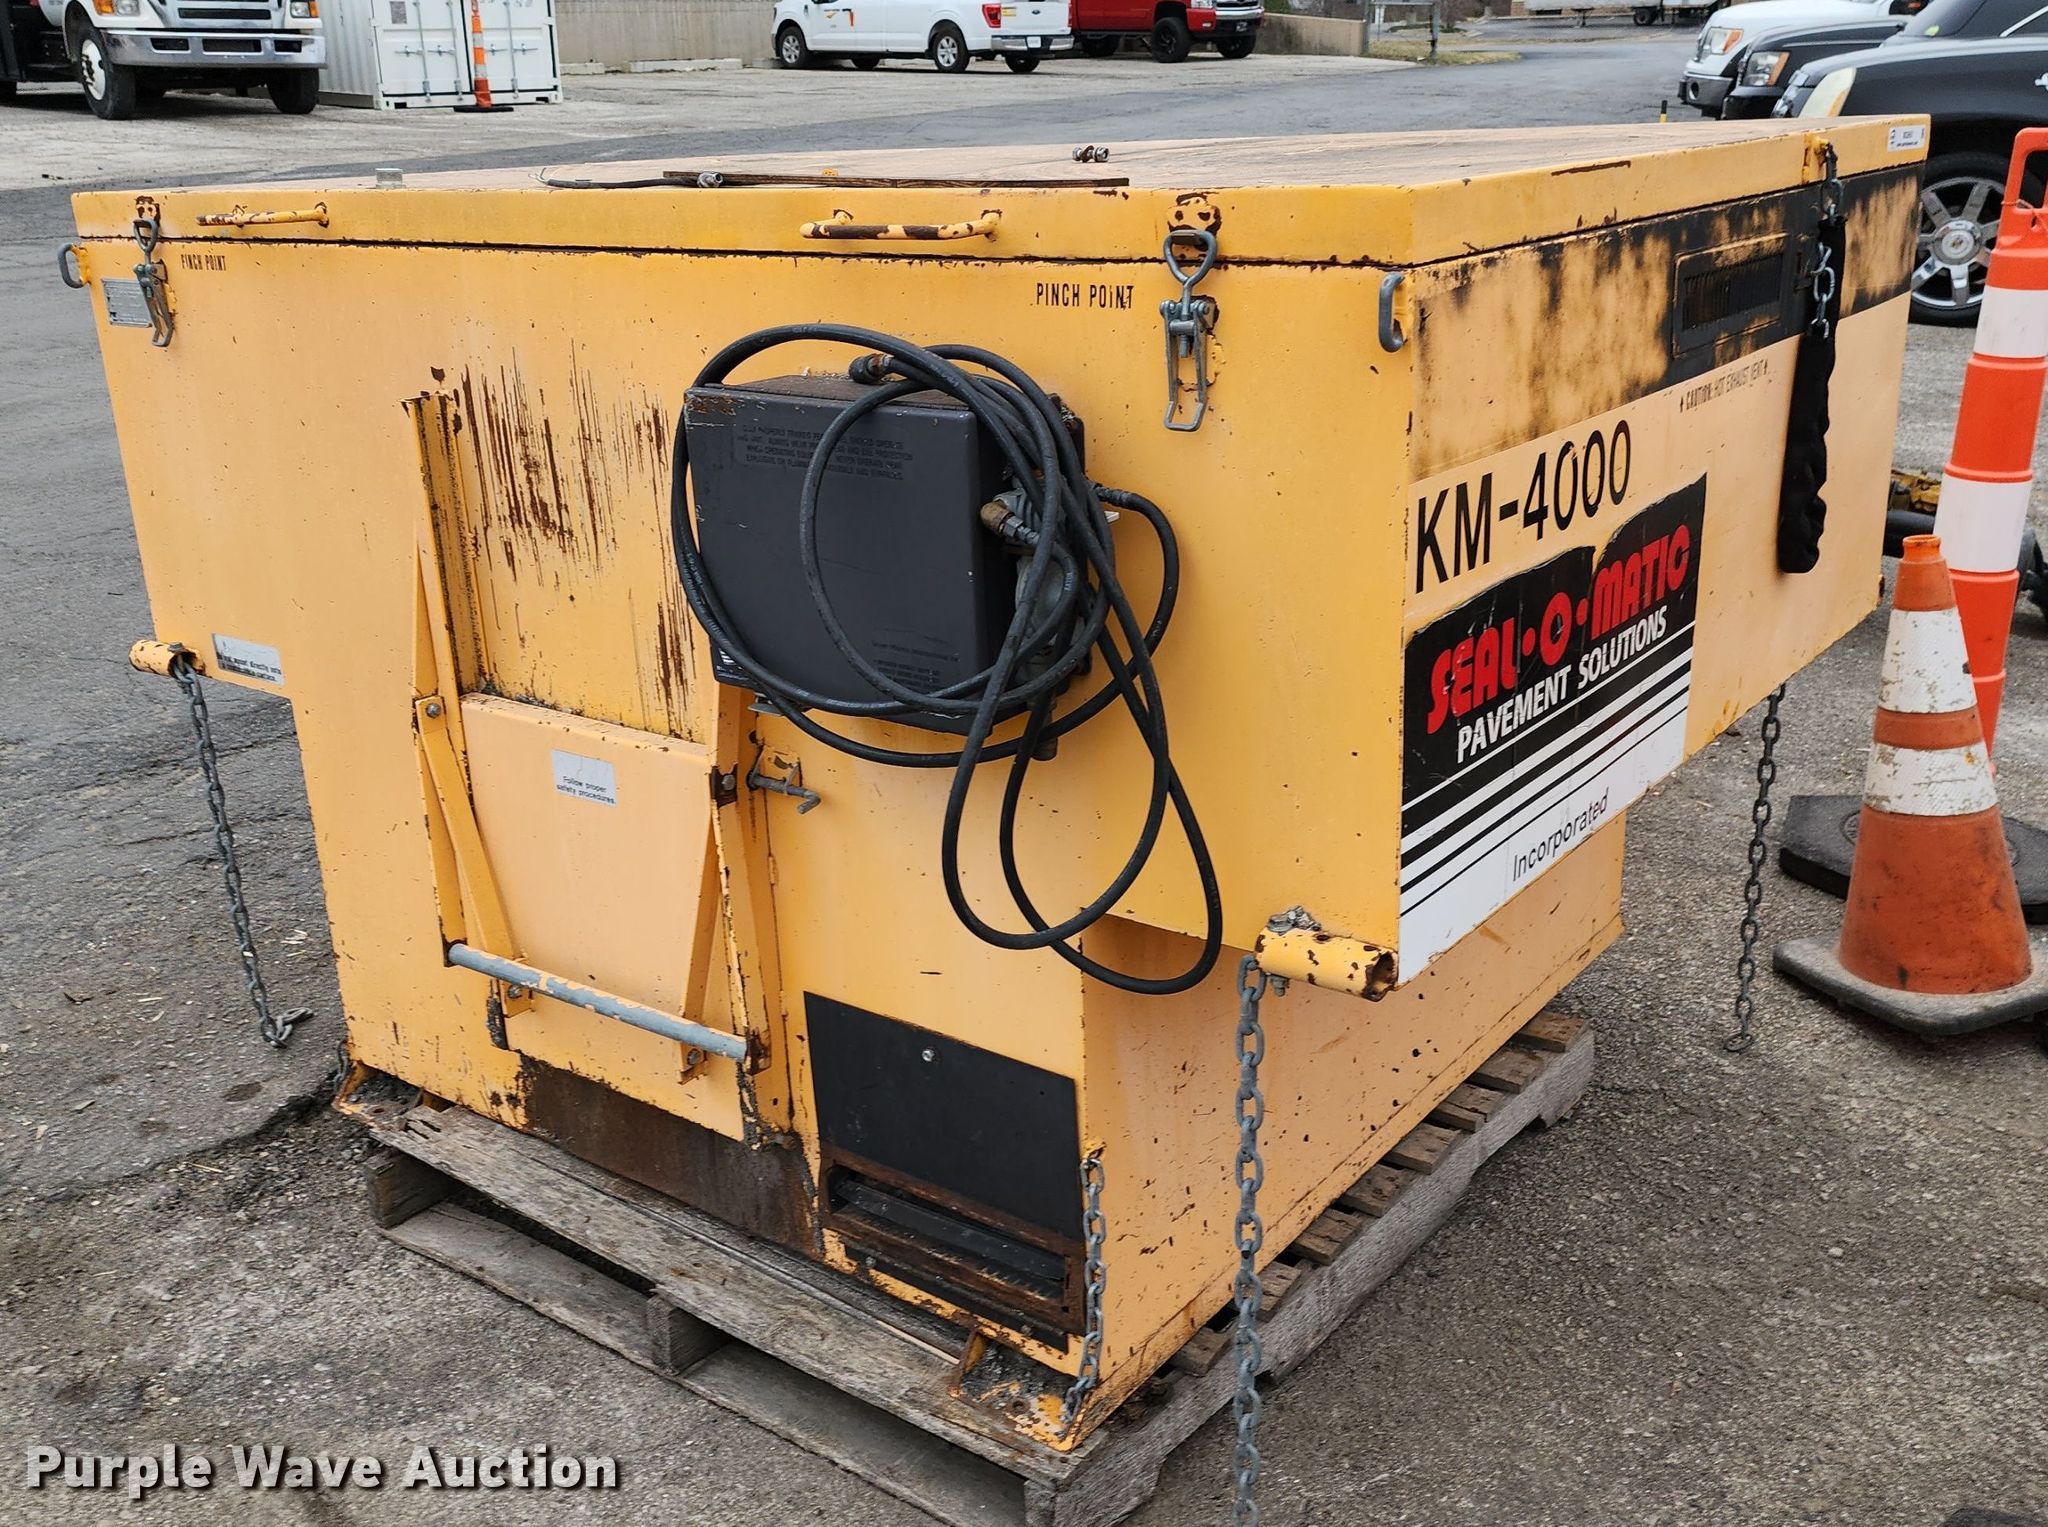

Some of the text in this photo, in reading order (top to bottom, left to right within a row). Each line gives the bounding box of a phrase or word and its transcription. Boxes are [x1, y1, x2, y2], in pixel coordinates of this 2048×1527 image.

[204, 255, 227, 271] POINT
[1036, 282, 1134, 309] PINCH POINT
[1415, 419, 1631, 594] KM-4000
[1457, 605, 1668, 763] PAVEMENT SOLUTIONS
[1512, 786, 1609, 881] Incorporated
